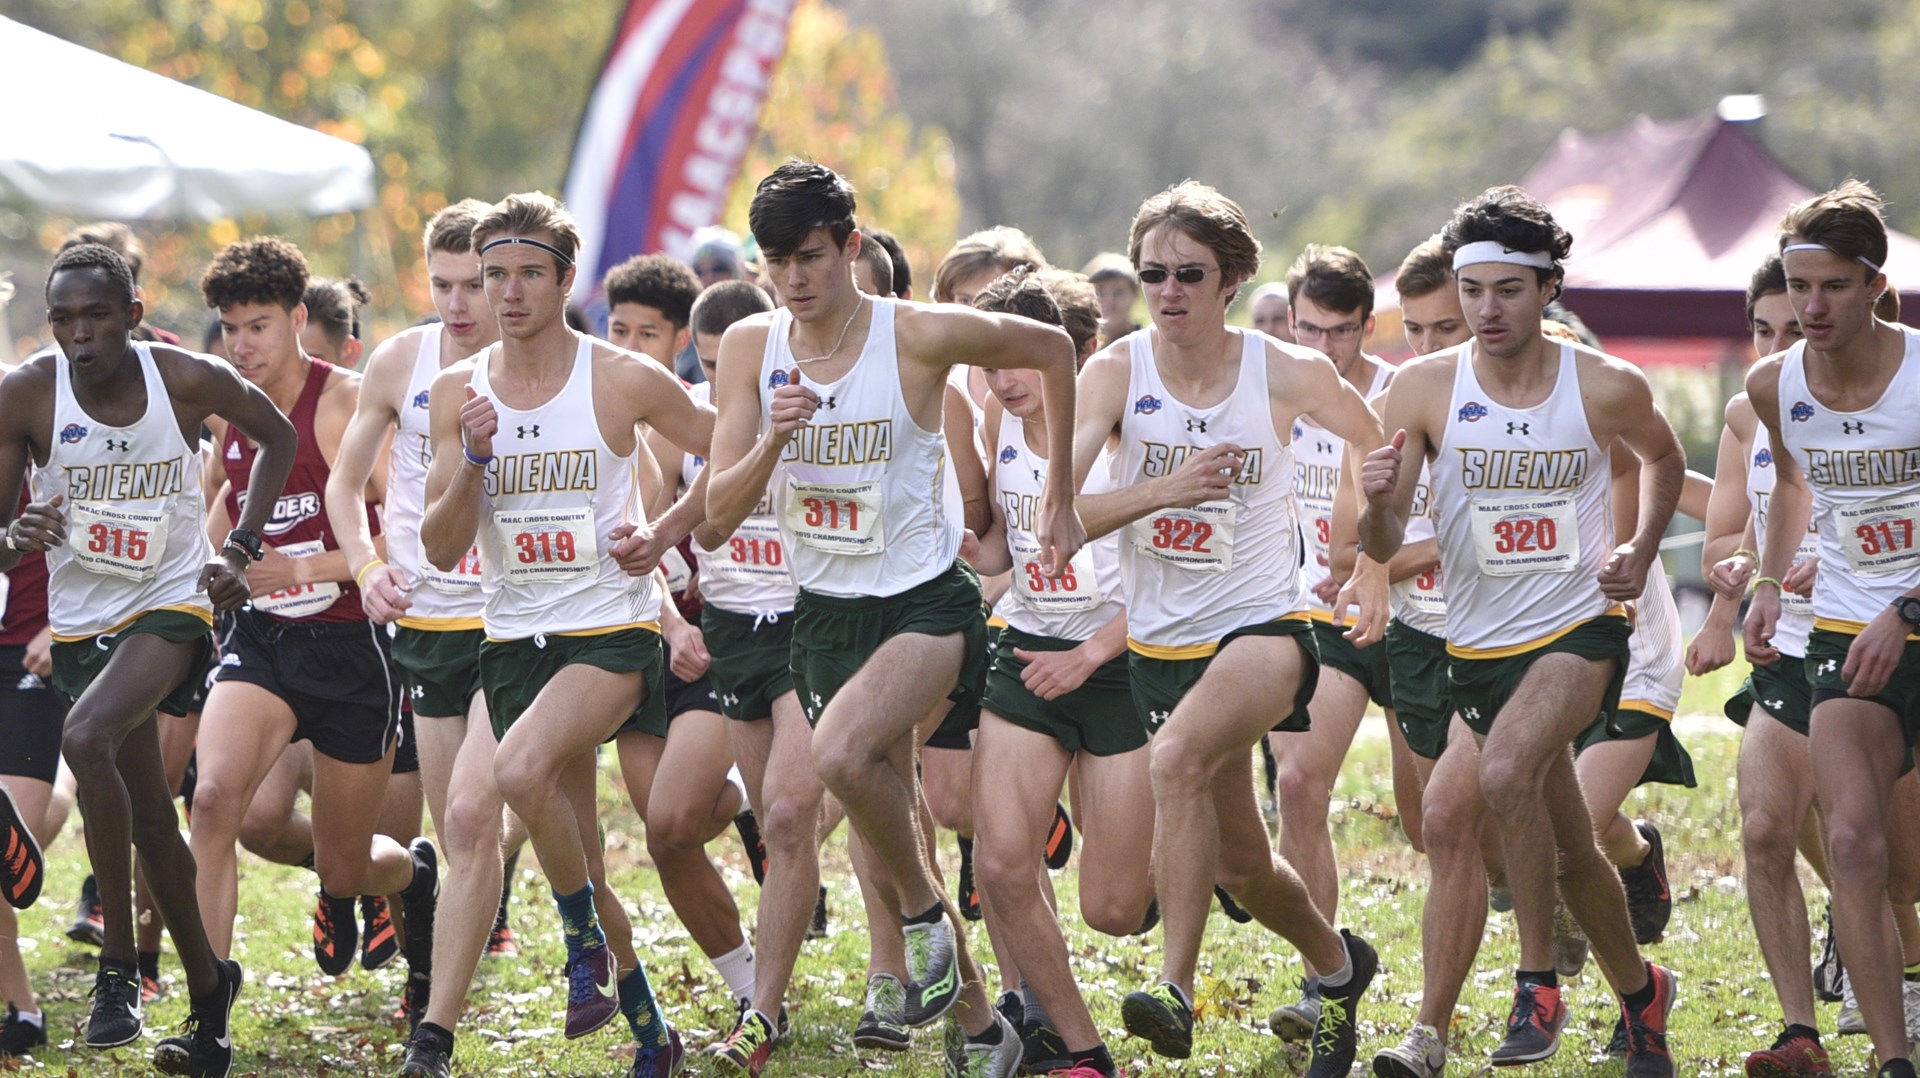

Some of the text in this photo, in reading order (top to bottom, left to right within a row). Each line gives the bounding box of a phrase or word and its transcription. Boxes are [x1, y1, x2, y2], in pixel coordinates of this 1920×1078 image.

[1134, 397, 1162, 415] MAAC
[1458, 404, 1488, 423] MAAC
[1790, 404, 1815, 422] MAAC
[60, 426, 88, 445] MAAC
[781, 419, 893, 466] SIENA
[483, 449, 598, 497] SIENA
[1139, 440, 1263, 485] SIA
[1454, 447, 1589, 490] SIENA
[1800, 446, 1920, 488] SIENA
[60, 456, 183, 501] SIENA
[836, 485, 873, 494] COUNTRY
[1293, 462, 1340, 501] SIE
[78, 505, 163, 523] MAAC CROSS COUNTRY
[550, 514, 586, 522] COUNTRY
[802, 497, 859, 531] 311
[1193, 506, 1228, 514] COUNTRY
[1504, 503, 1530, 512] CROSS
[1532, 500, 1568, 510] COUNTRY
[1860, 506, 1885, 515] CROSS
[1886, 501, 1920, 511] COUNTRY
[88, 523, 149, 561] 315
[516, 530, 576, 564] 319
[1152, 518, 1213, 553] 322
[1494, 518, 1557, 554] 320
[1856, 518, 1913, 555] 317
[729, 537, 782, 566] 310
[1160, 553, 1223, 564] CHAMPIONSHIPS
[1505, 554, 1570, 566] CHAMPIONSHIPS
[443, 578, 481, 587] CHAMPION
